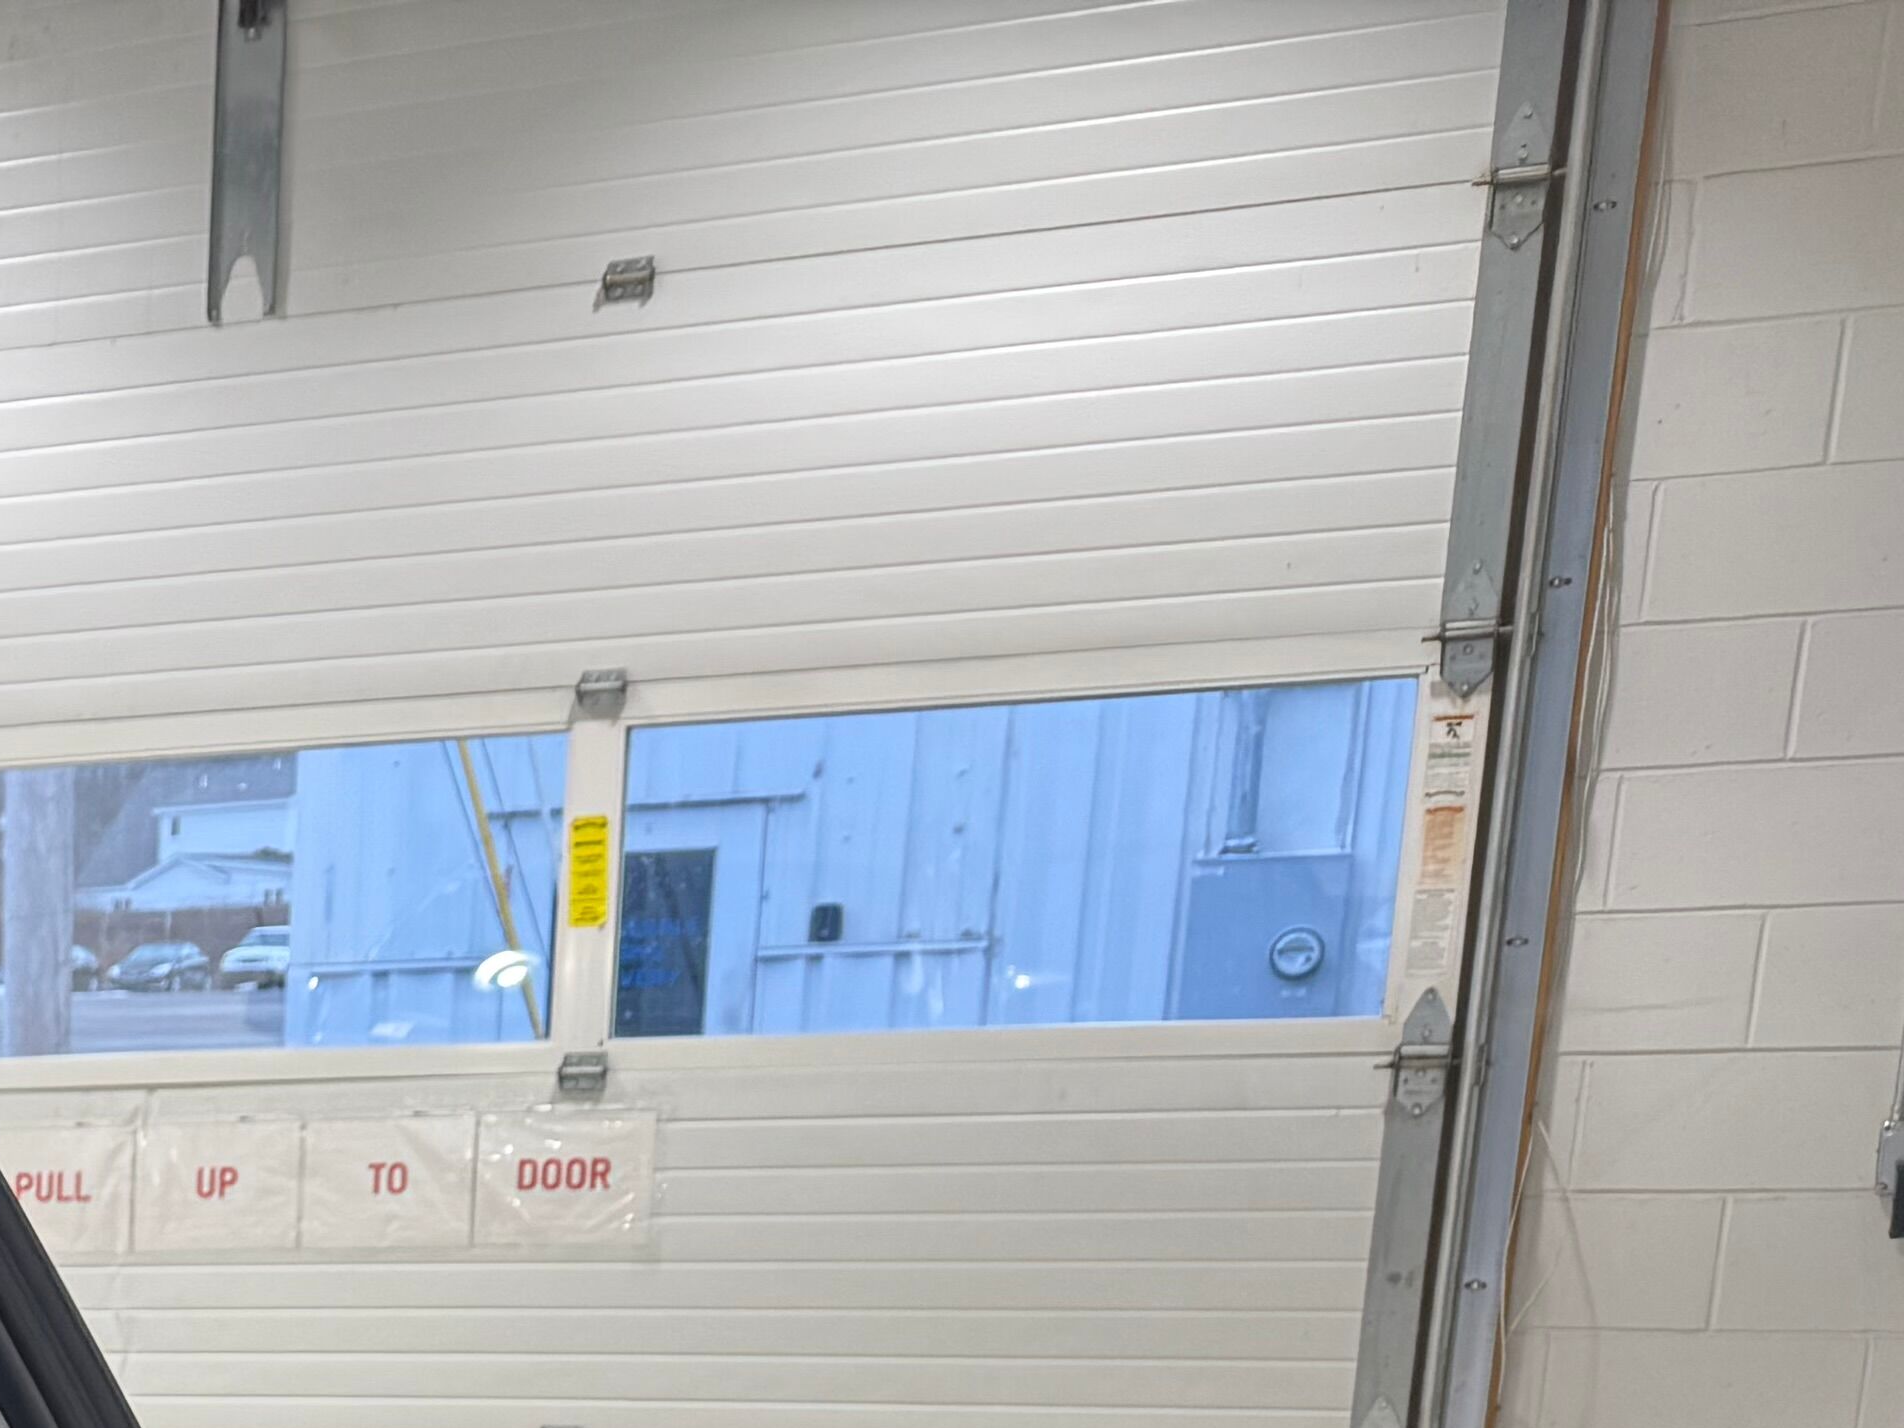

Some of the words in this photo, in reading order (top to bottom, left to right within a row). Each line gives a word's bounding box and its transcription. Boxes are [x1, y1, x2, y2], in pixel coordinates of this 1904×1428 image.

[15, 1171, 91, 1203] PULL
[196, 1168, 239, 1198] UP
[368, 1162, 409, 1195] TO
[516, 1158, 612, 1191] DOOR
